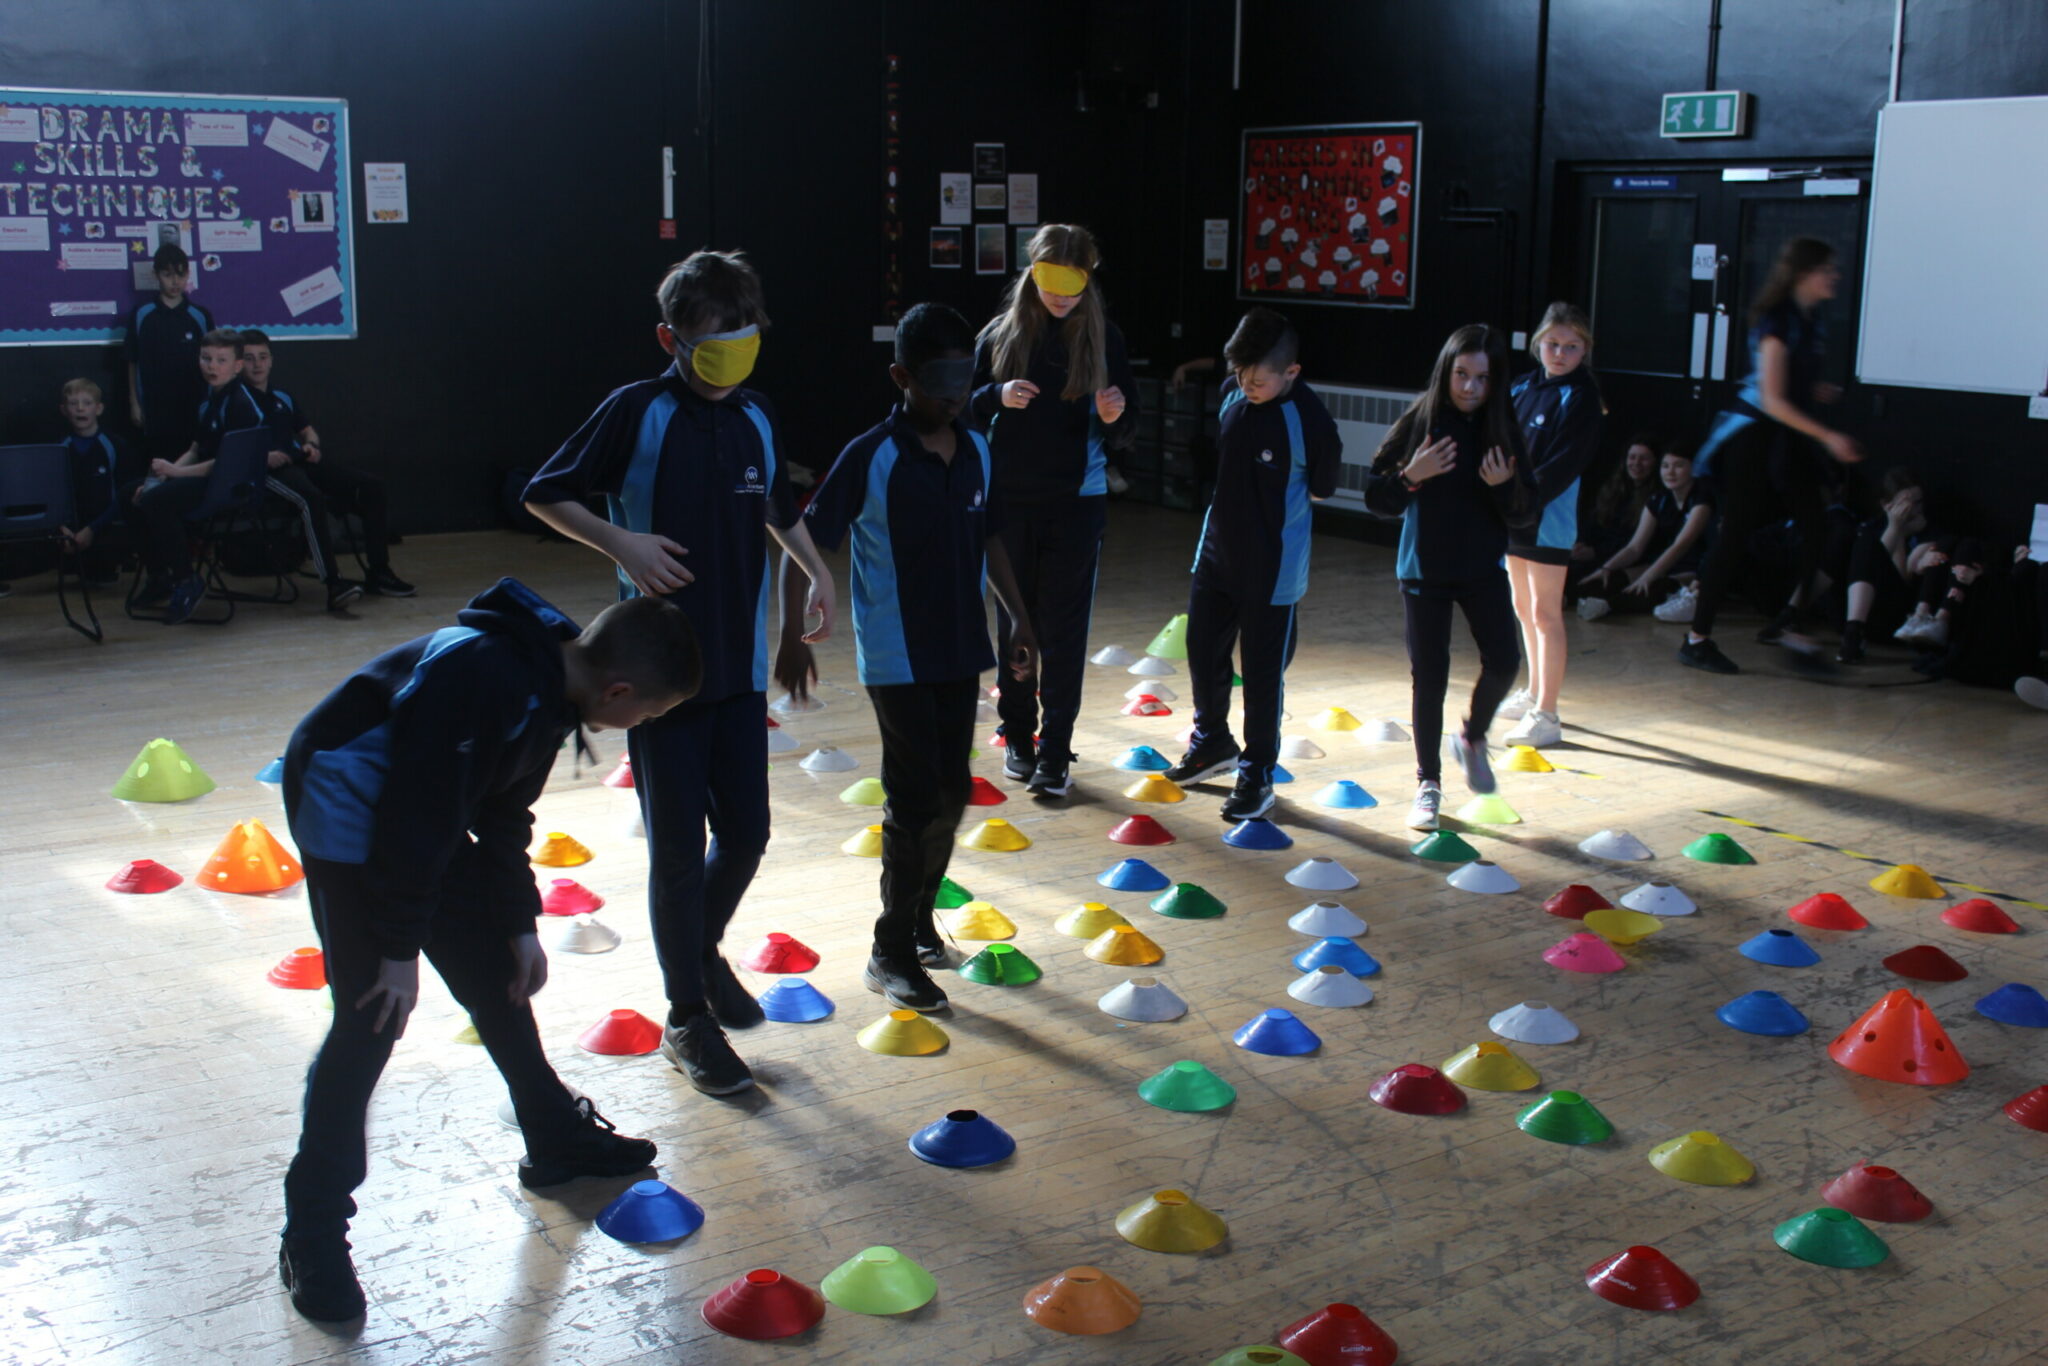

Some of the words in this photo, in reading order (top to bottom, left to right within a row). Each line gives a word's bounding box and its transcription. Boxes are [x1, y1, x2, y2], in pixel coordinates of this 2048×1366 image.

[41, 107, 181, 144] DRAMA
[33, 141, 159, 178] SKILLS
[180, 146, 204, 178] &
[1249, 139, 1337, 168] CAREERS
[1351, 138, 1374, 168] IN
[0, 182, 241, 220] TECHNIQUES
[1255, 168, 1372, 203] PERFORMING
[1294, 201, 1341, 233] ARTS
